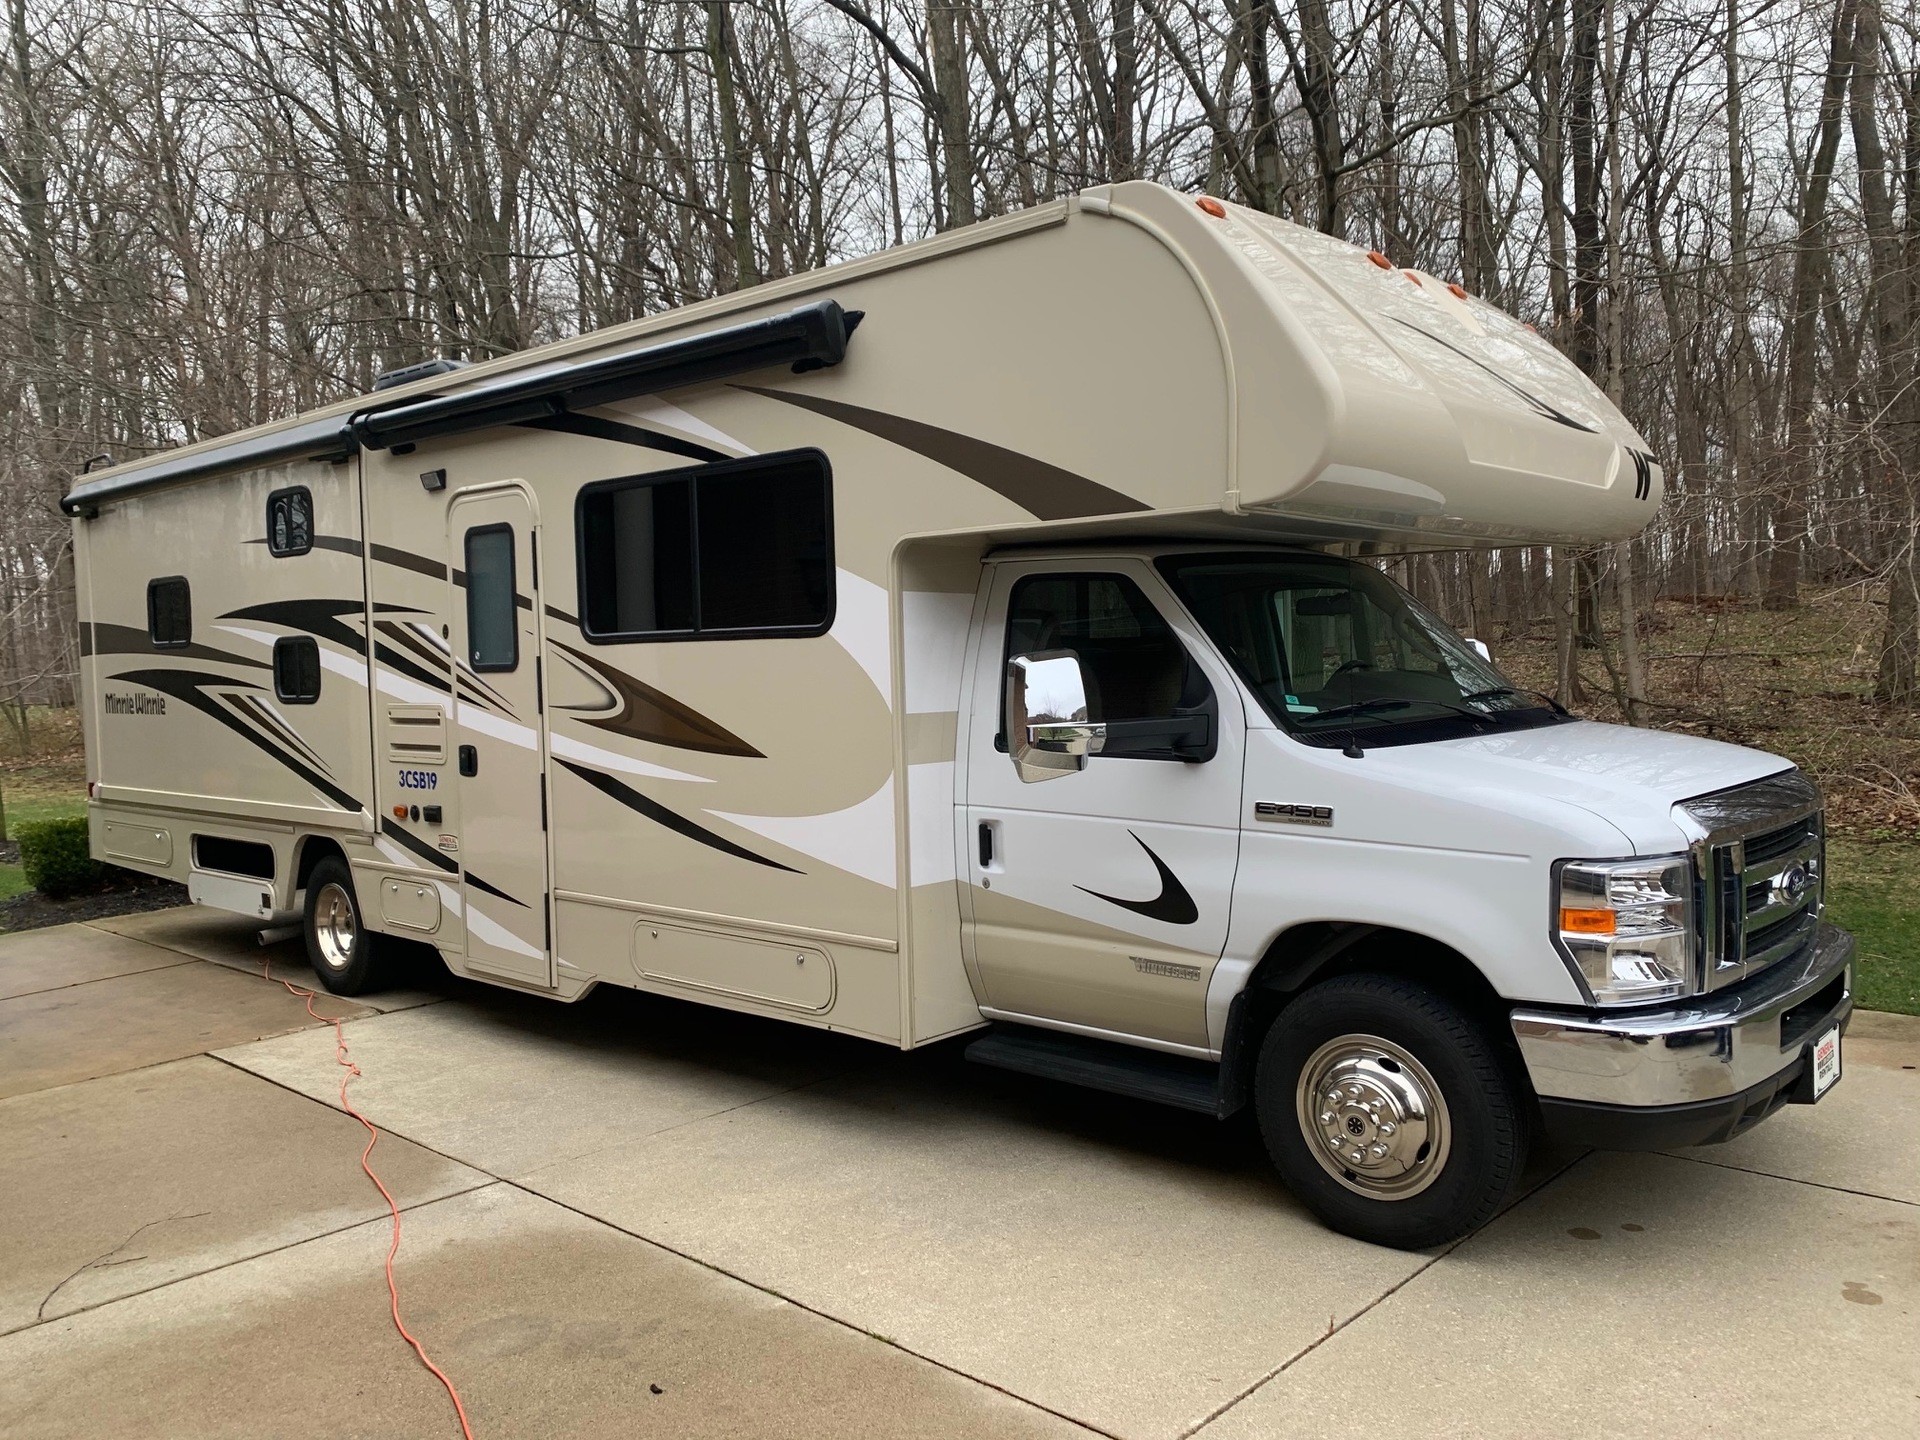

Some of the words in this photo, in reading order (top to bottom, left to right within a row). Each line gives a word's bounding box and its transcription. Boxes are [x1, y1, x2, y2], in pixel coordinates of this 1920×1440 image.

[105, 693, 134, 714] Minnie
[134, 693, 167, 715] Winnie
[398, 769, 438, 790] 3CSB19
